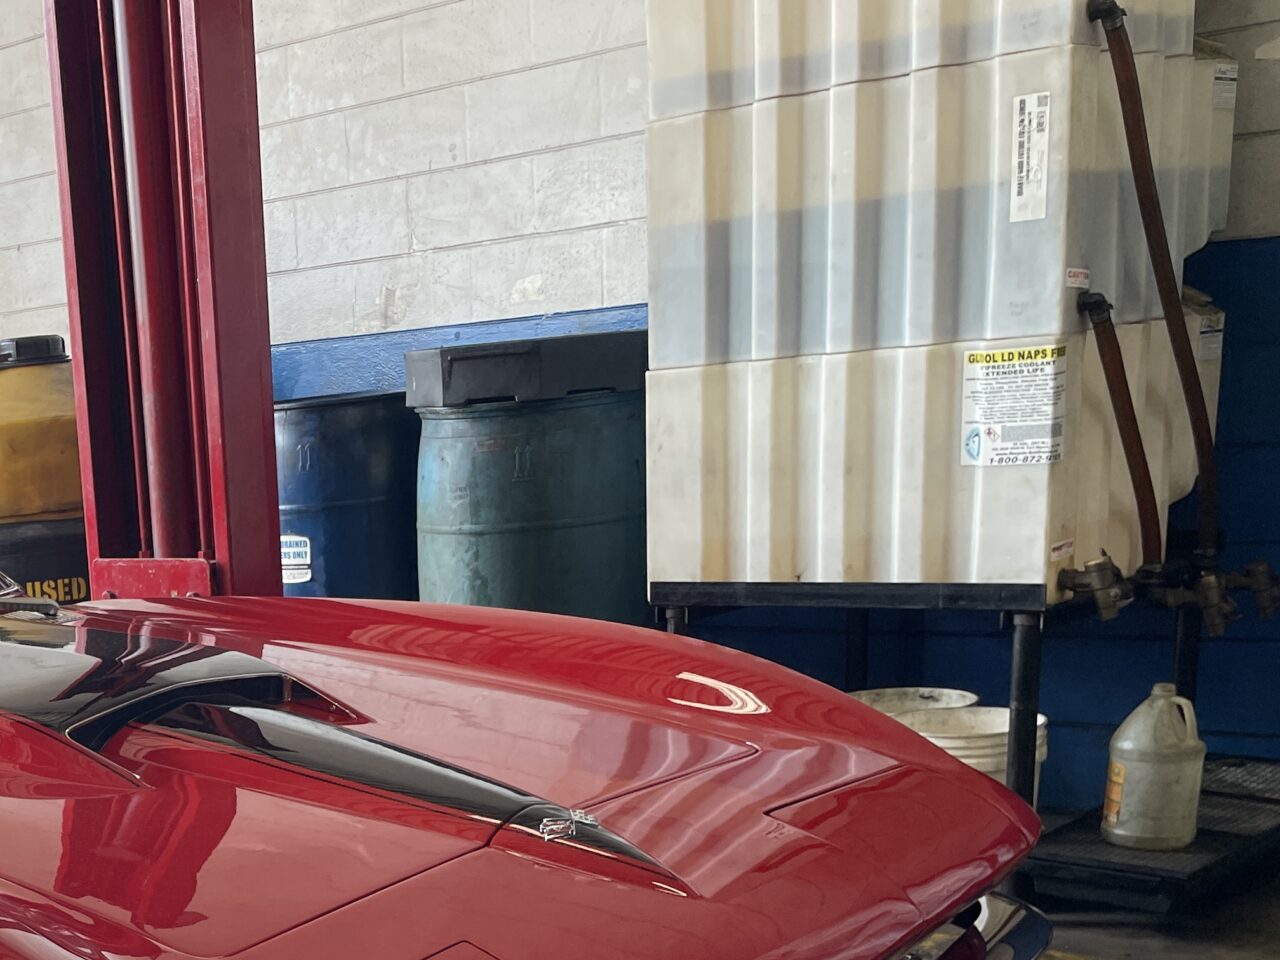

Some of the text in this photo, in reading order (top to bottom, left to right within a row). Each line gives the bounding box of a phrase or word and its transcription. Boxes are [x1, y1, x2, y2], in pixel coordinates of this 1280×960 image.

[1018, 360, 1056, 368] COOLANT
[1027, 367, 1045, 375] LIFE
[292, 551, 308, 559] ONLY
[25, 577, 87, 601] USED
